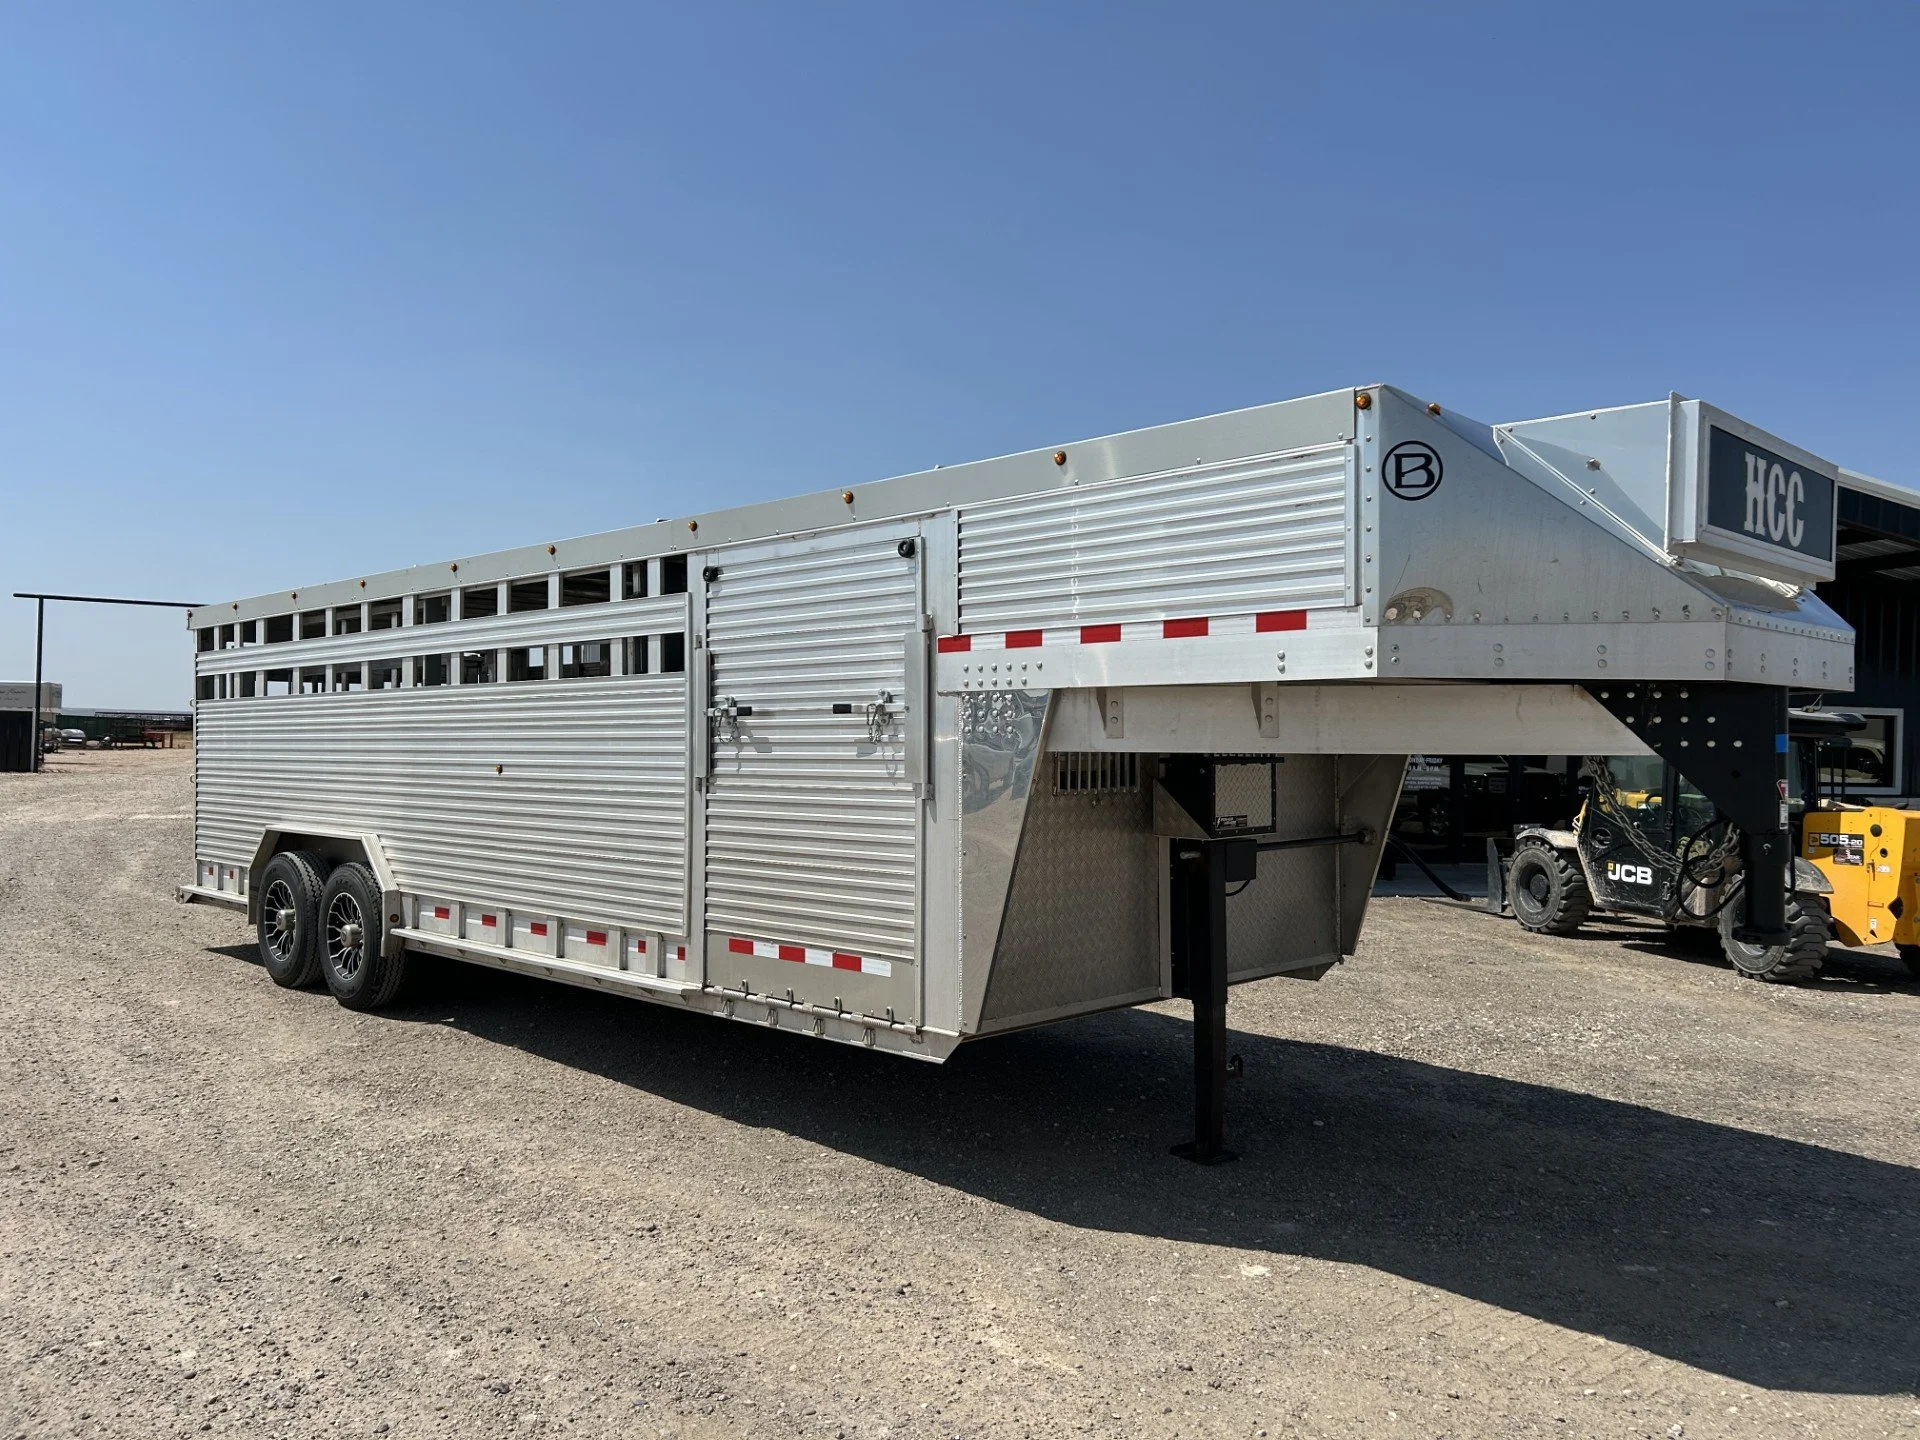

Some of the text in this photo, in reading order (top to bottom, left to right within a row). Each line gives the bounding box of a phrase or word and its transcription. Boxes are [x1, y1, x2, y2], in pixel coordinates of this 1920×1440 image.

[1393, 453, 1435, 489] B
[1743, 451, 1805, 548] HCC
[1607, 862, 1653, 885] JCB
